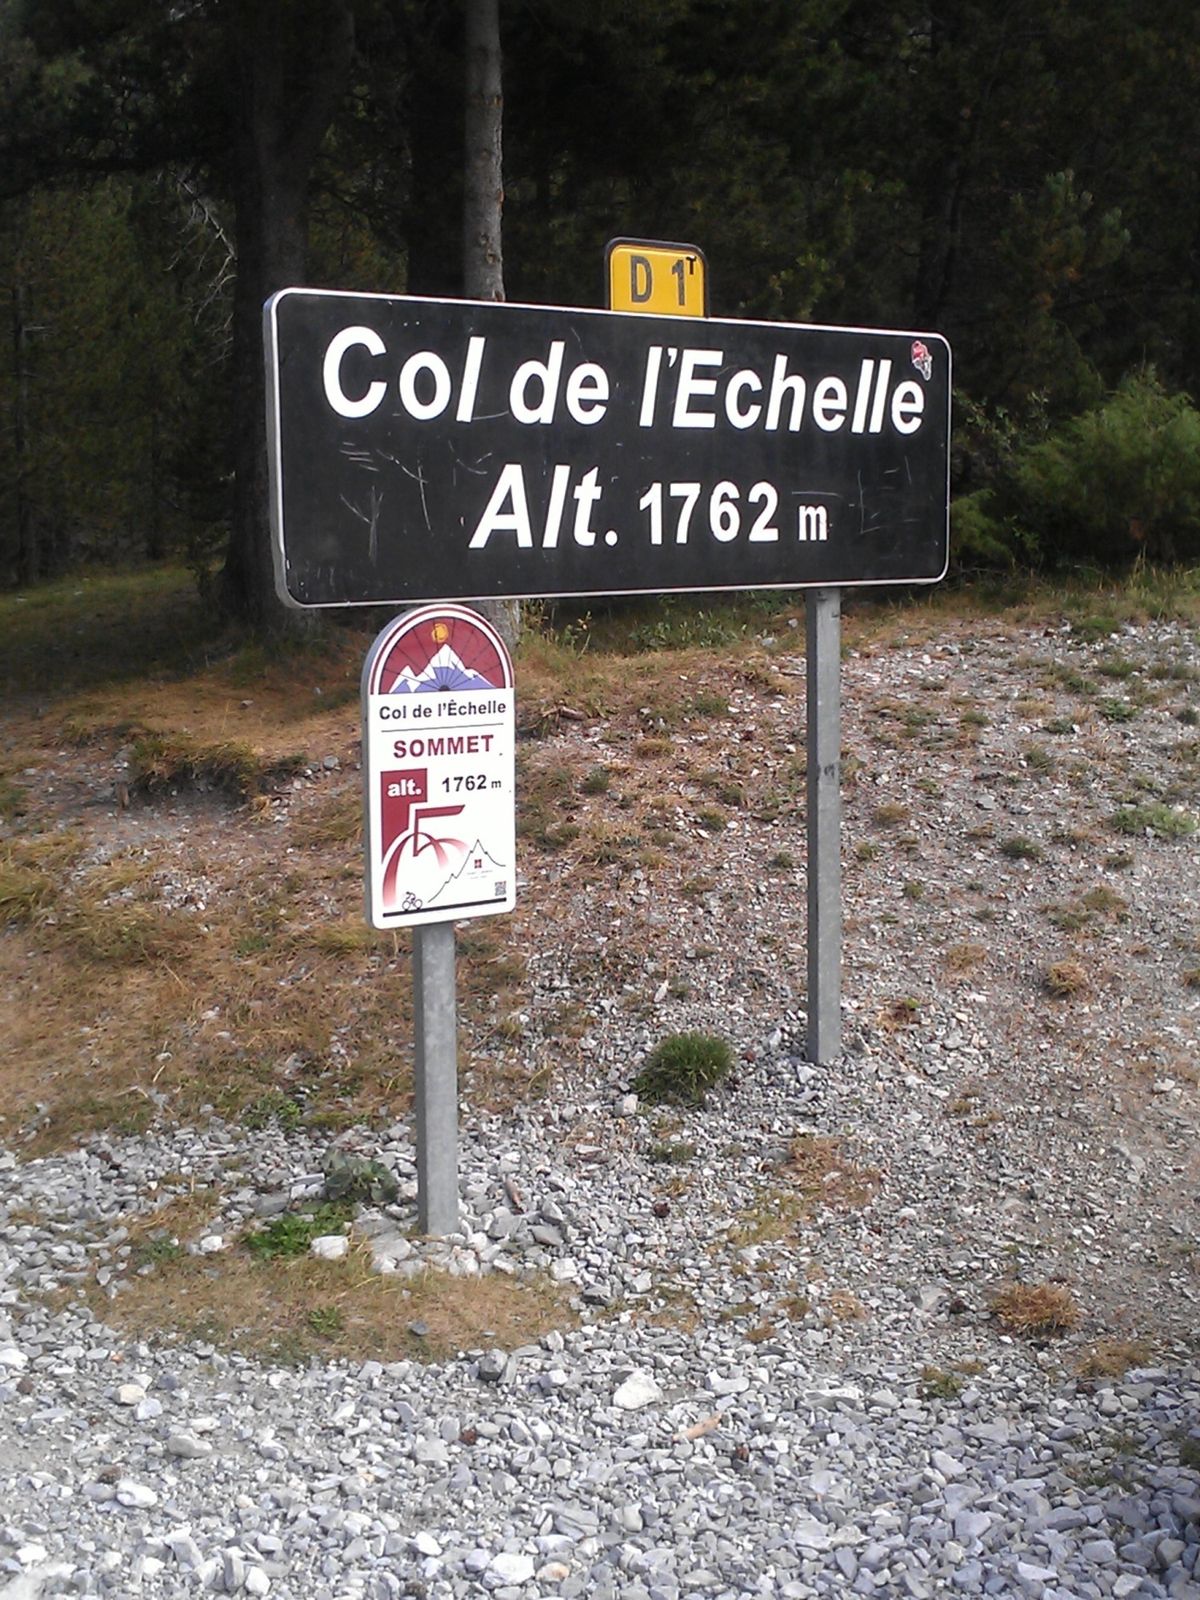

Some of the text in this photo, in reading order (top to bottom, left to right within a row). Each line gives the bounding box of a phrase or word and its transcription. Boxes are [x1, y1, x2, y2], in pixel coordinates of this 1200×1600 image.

[630, 255, 652, 303] D
[322, 326, 925, 434] Col de l'Echelle
[469, 464, 828, 549] Alt. 1762 m
[379, 705, 407, 720] Col
[412, 704, 433, 719] de
[393, 734, 494, 759] SOMMET
[387, 774, 502, 797] alt. 1762 m
